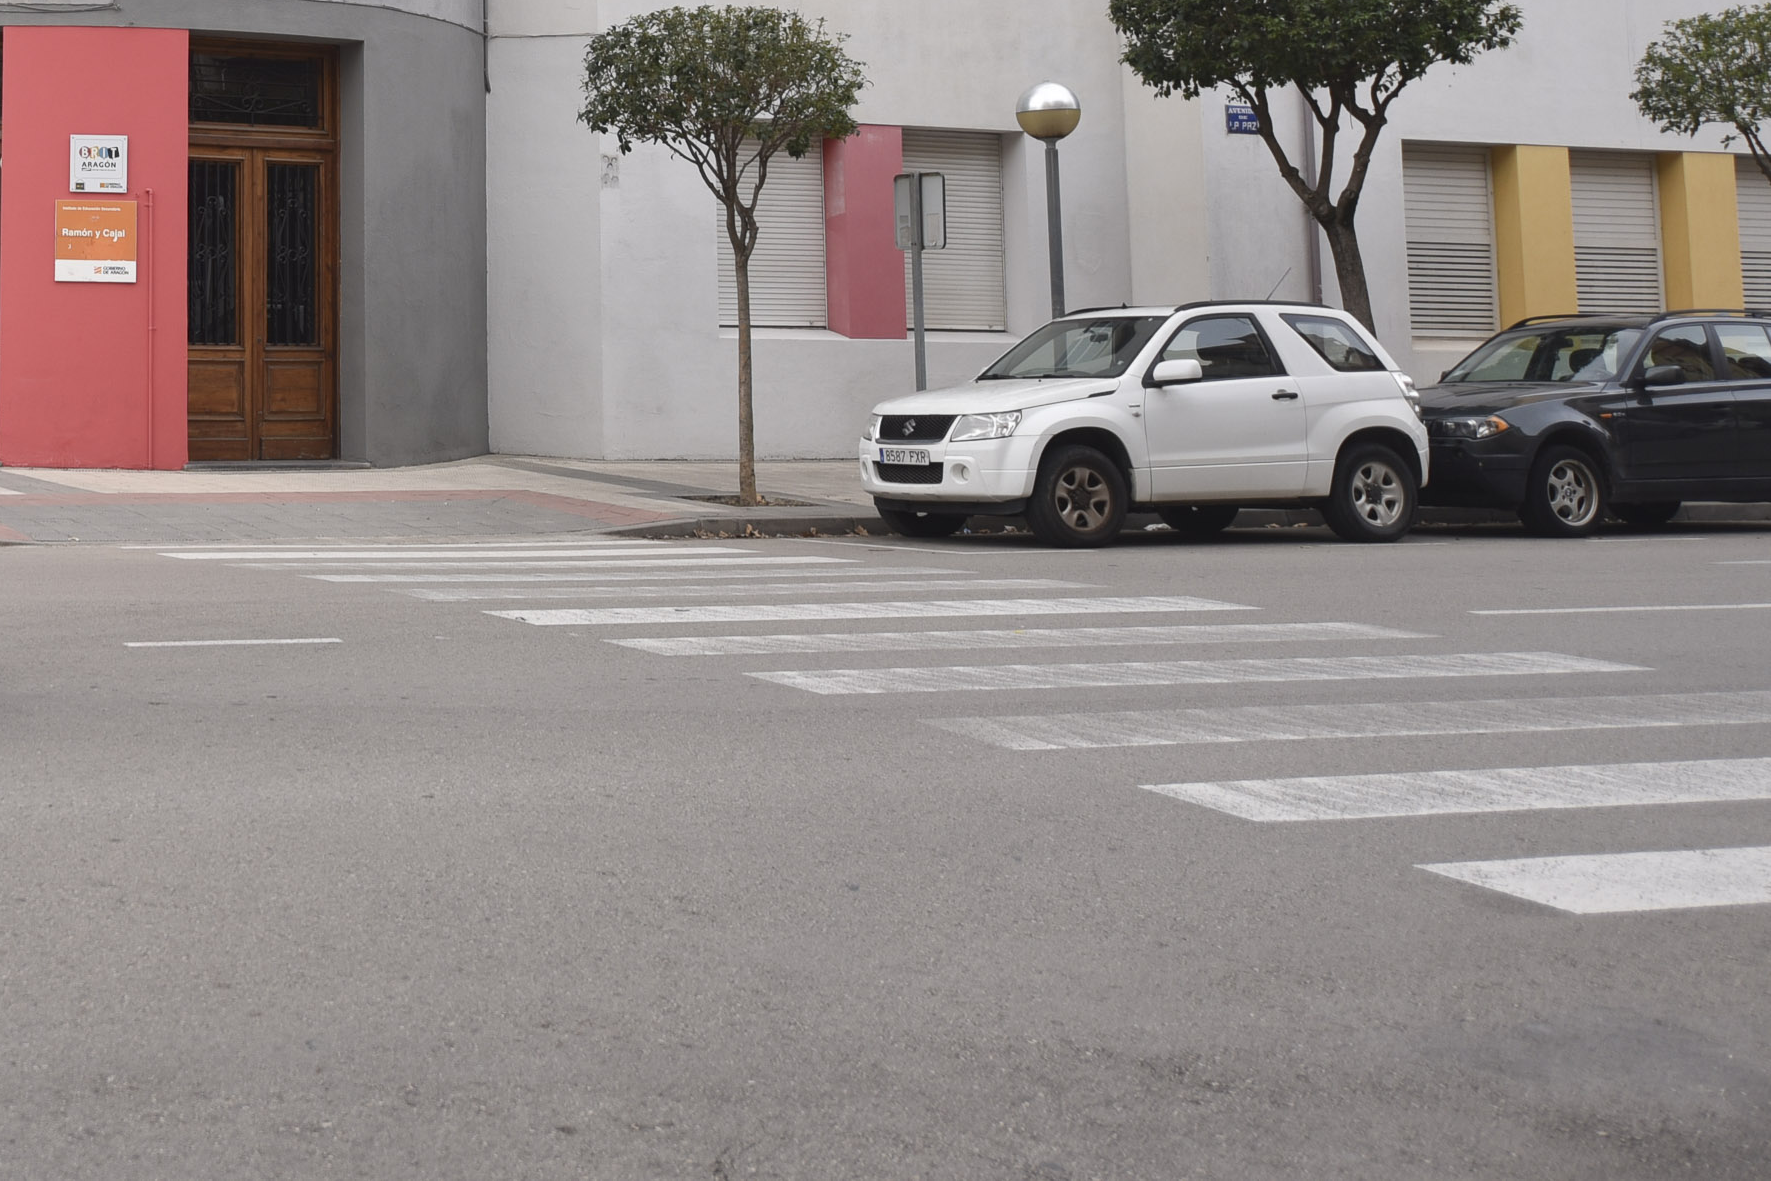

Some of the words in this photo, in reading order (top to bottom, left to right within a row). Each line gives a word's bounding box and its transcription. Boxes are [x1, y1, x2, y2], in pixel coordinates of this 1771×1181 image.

[80, 146, 119, 160] BRIT
[62, 227, 93, 237] Ramón
[95, 230, 101, 239] y
[102, 229, 126, 243] Cajal
[885, 449, 906, 463] 8587
[909, 450, 927, 464] FXR
